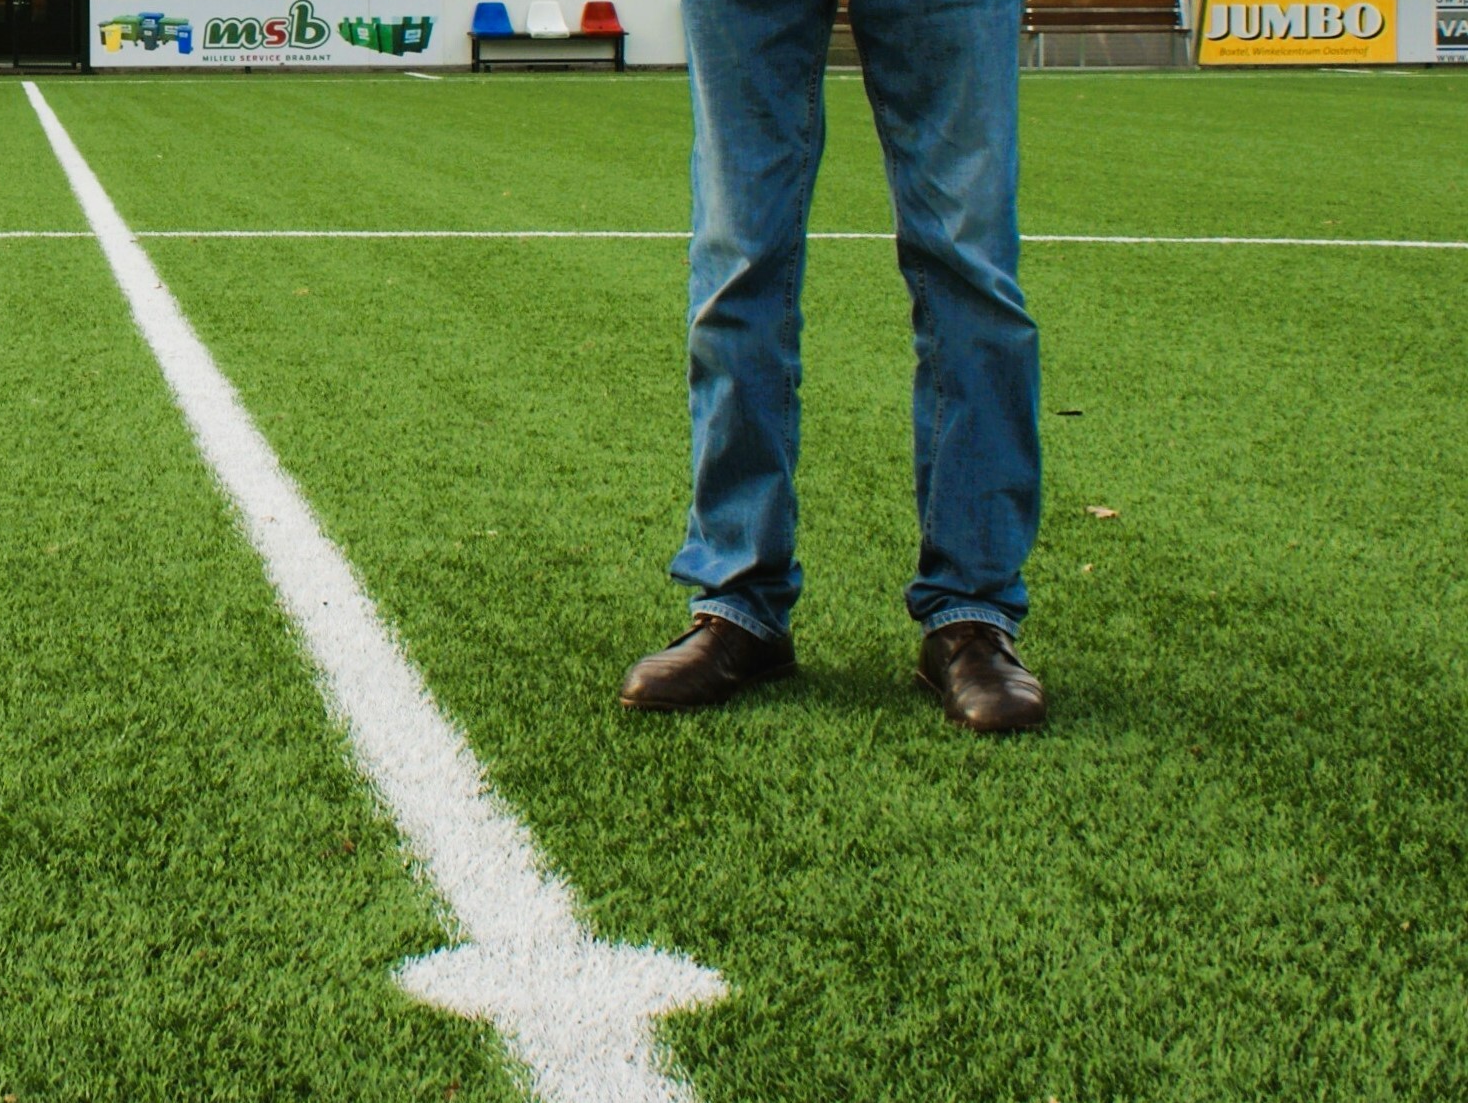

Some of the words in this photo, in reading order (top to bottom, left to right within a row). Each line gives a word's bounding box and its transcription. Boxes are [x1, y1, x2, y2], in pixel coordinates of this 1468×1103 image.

[202, 0, 331, 50] msb
[1204, 1, 1386, 42] JUMBO
[285, 54, 331, 62] BRABANT
